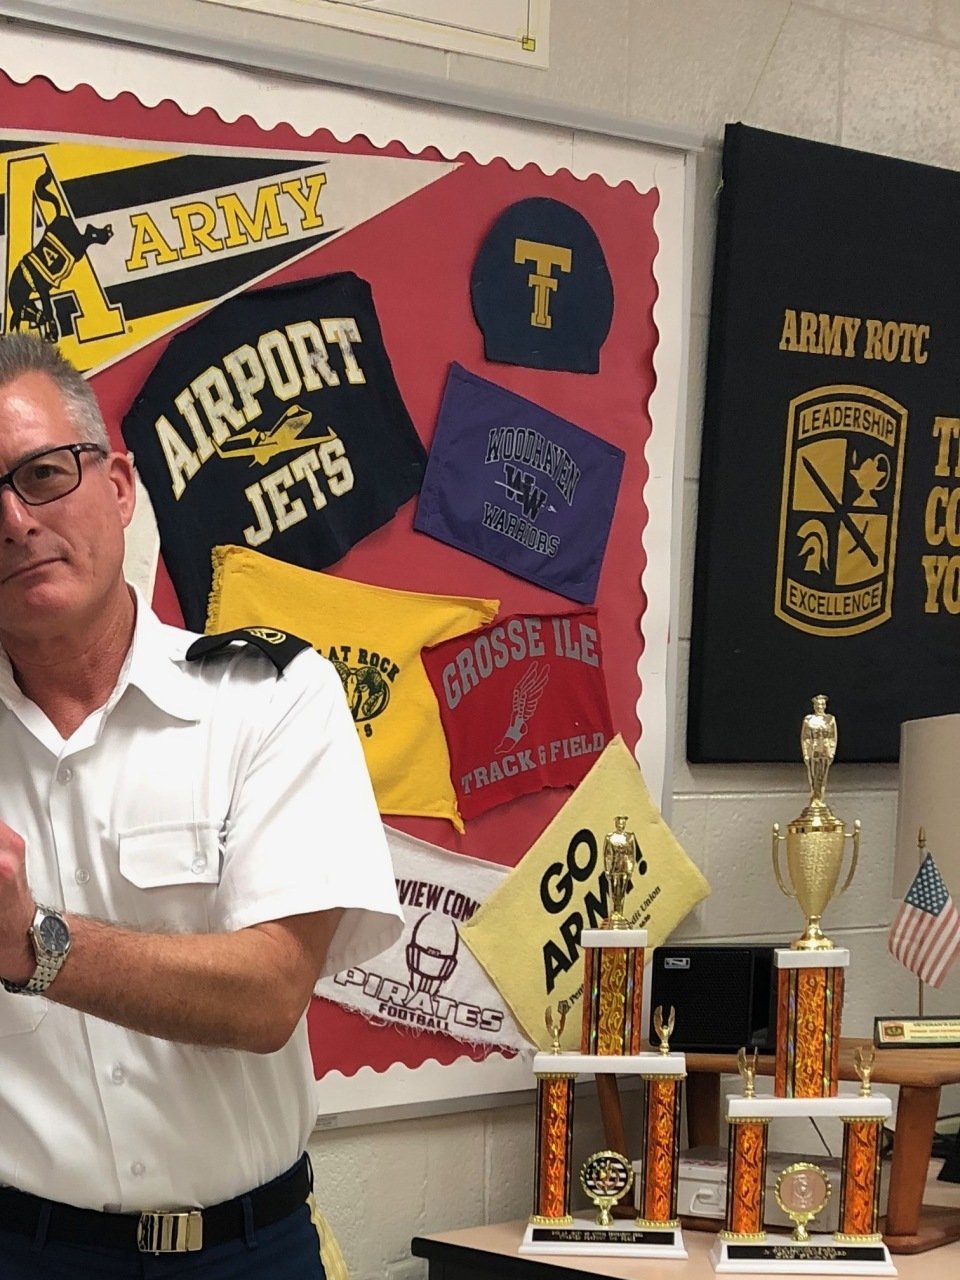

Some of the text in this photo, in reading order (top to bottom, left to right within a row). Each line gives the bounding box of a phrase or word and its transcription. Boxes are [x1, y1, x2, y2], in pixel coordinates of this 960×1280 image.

[125, 172, 328, 273] ARMY
[779, 309, 930, 365] ARMY ROTC
[155, 317, 367, 500] AIRPORT
[801, 406, 894, 437] LEADERSHIP
[243, 439, 354, 546] JETS
[485, 427, 581, 506] WOODHAVEN
[482, 502, 560, 557] WARRIORS
[790, 585, 881, 617] EXCELLENCE
[358, 648, 400, 683] ROCK
[442, 617, 600, 710] GROSSE ILE
[460, 748, 537, 795] TRACK
[550, 731, 605, 763] FIELD
[541, 828, 598, 915] GO
[640, 885, 662, 912] Union
[442, 889, 482, 922] COM
[334, 966, 505, 1032] PIRATES
[378, 1003, 450, 1031] FOOTBALL
